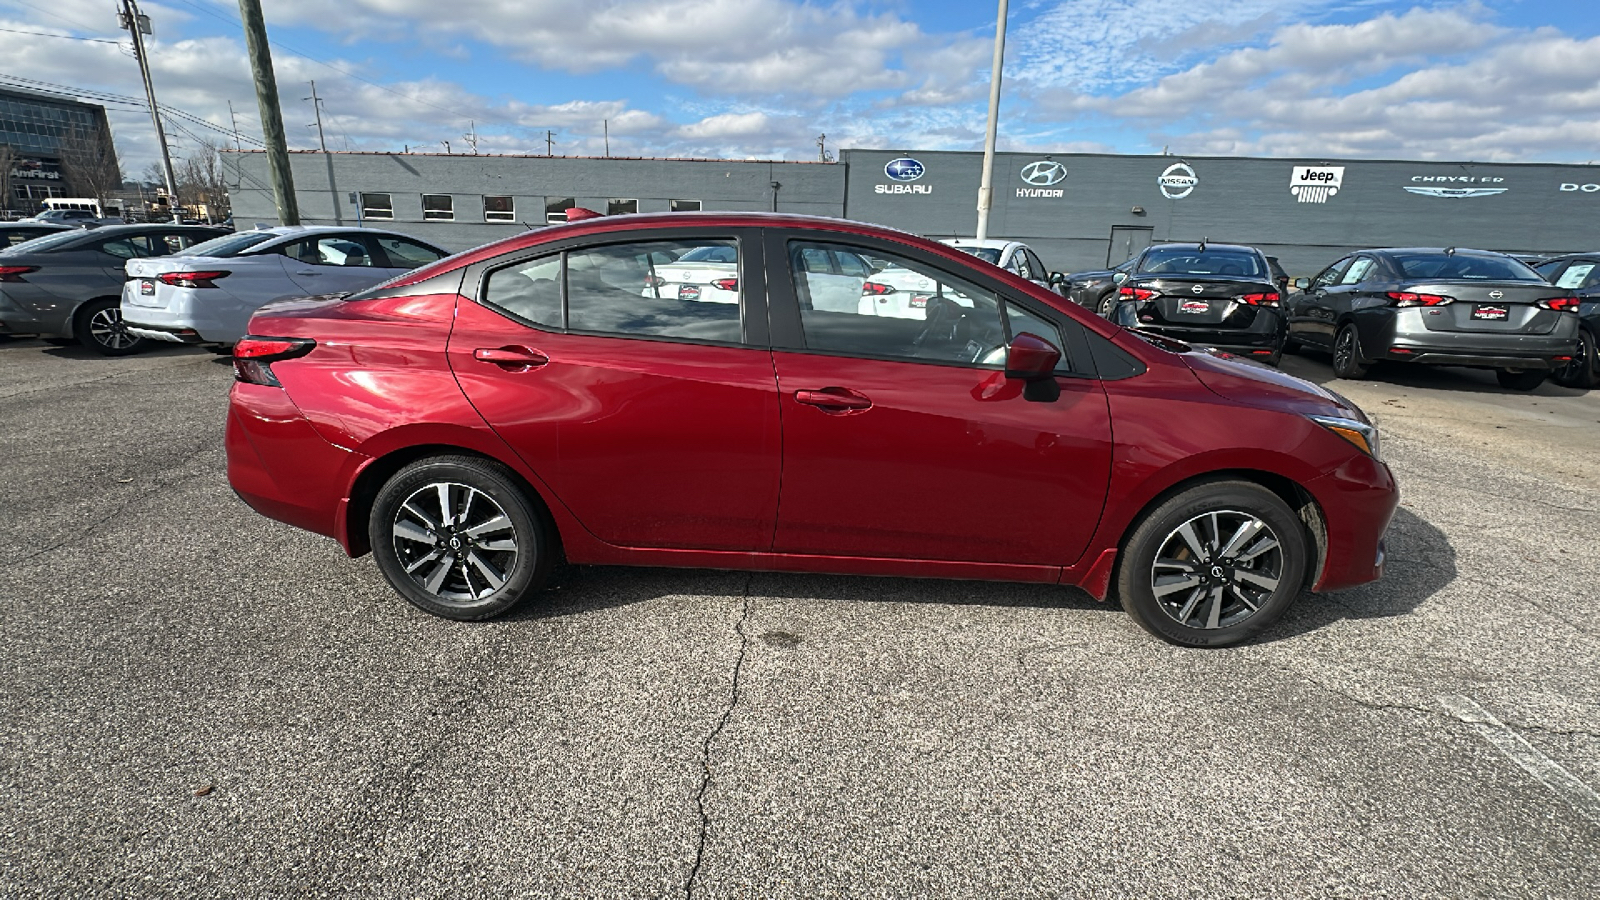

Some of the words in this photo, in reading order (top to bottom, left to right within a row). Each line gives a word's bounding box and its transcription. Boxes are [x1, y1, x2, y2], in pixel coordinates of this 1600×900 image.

[10, 168, 60, 179] AmFirst
[1300, 169, 1334, 183] Jeep
[874, 184, 932, 194] SUBARU
[1016, 188, 1064, 198] HYUNDAI
[1161, 626, 1209, 645] KUMHO
